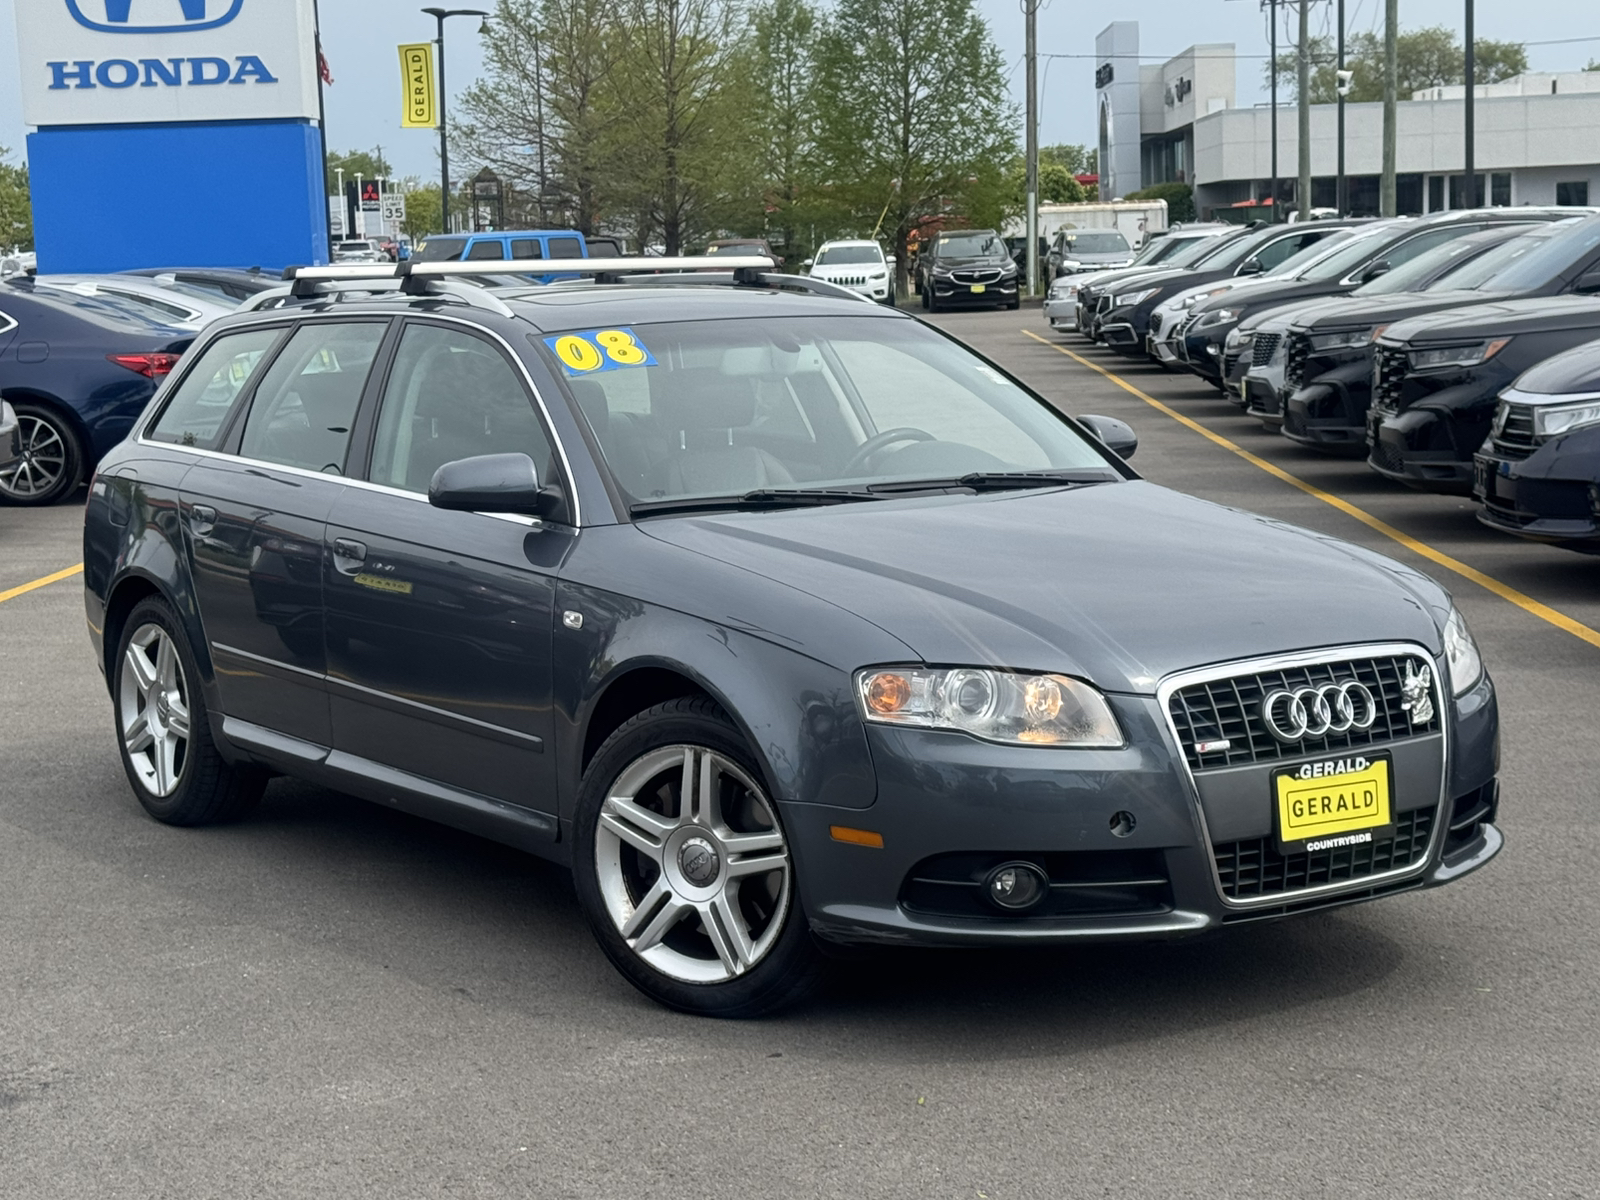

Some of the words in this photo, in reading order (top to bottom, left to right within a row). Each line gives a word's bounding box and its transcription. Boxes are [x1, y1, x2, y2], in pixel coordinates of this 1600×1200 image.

[46, 55, 278, 90] HONDA
[411, 54, 425, 117] GERALD
[385, 207, 404, 219] 35
[555, 330, 648, 372] 08
[1299, 757, 1366, 779] GERALD
[1292, 790, 1374, 818] GERALD
[1306, 833, 1372, 851] COUNTRYSIDE
